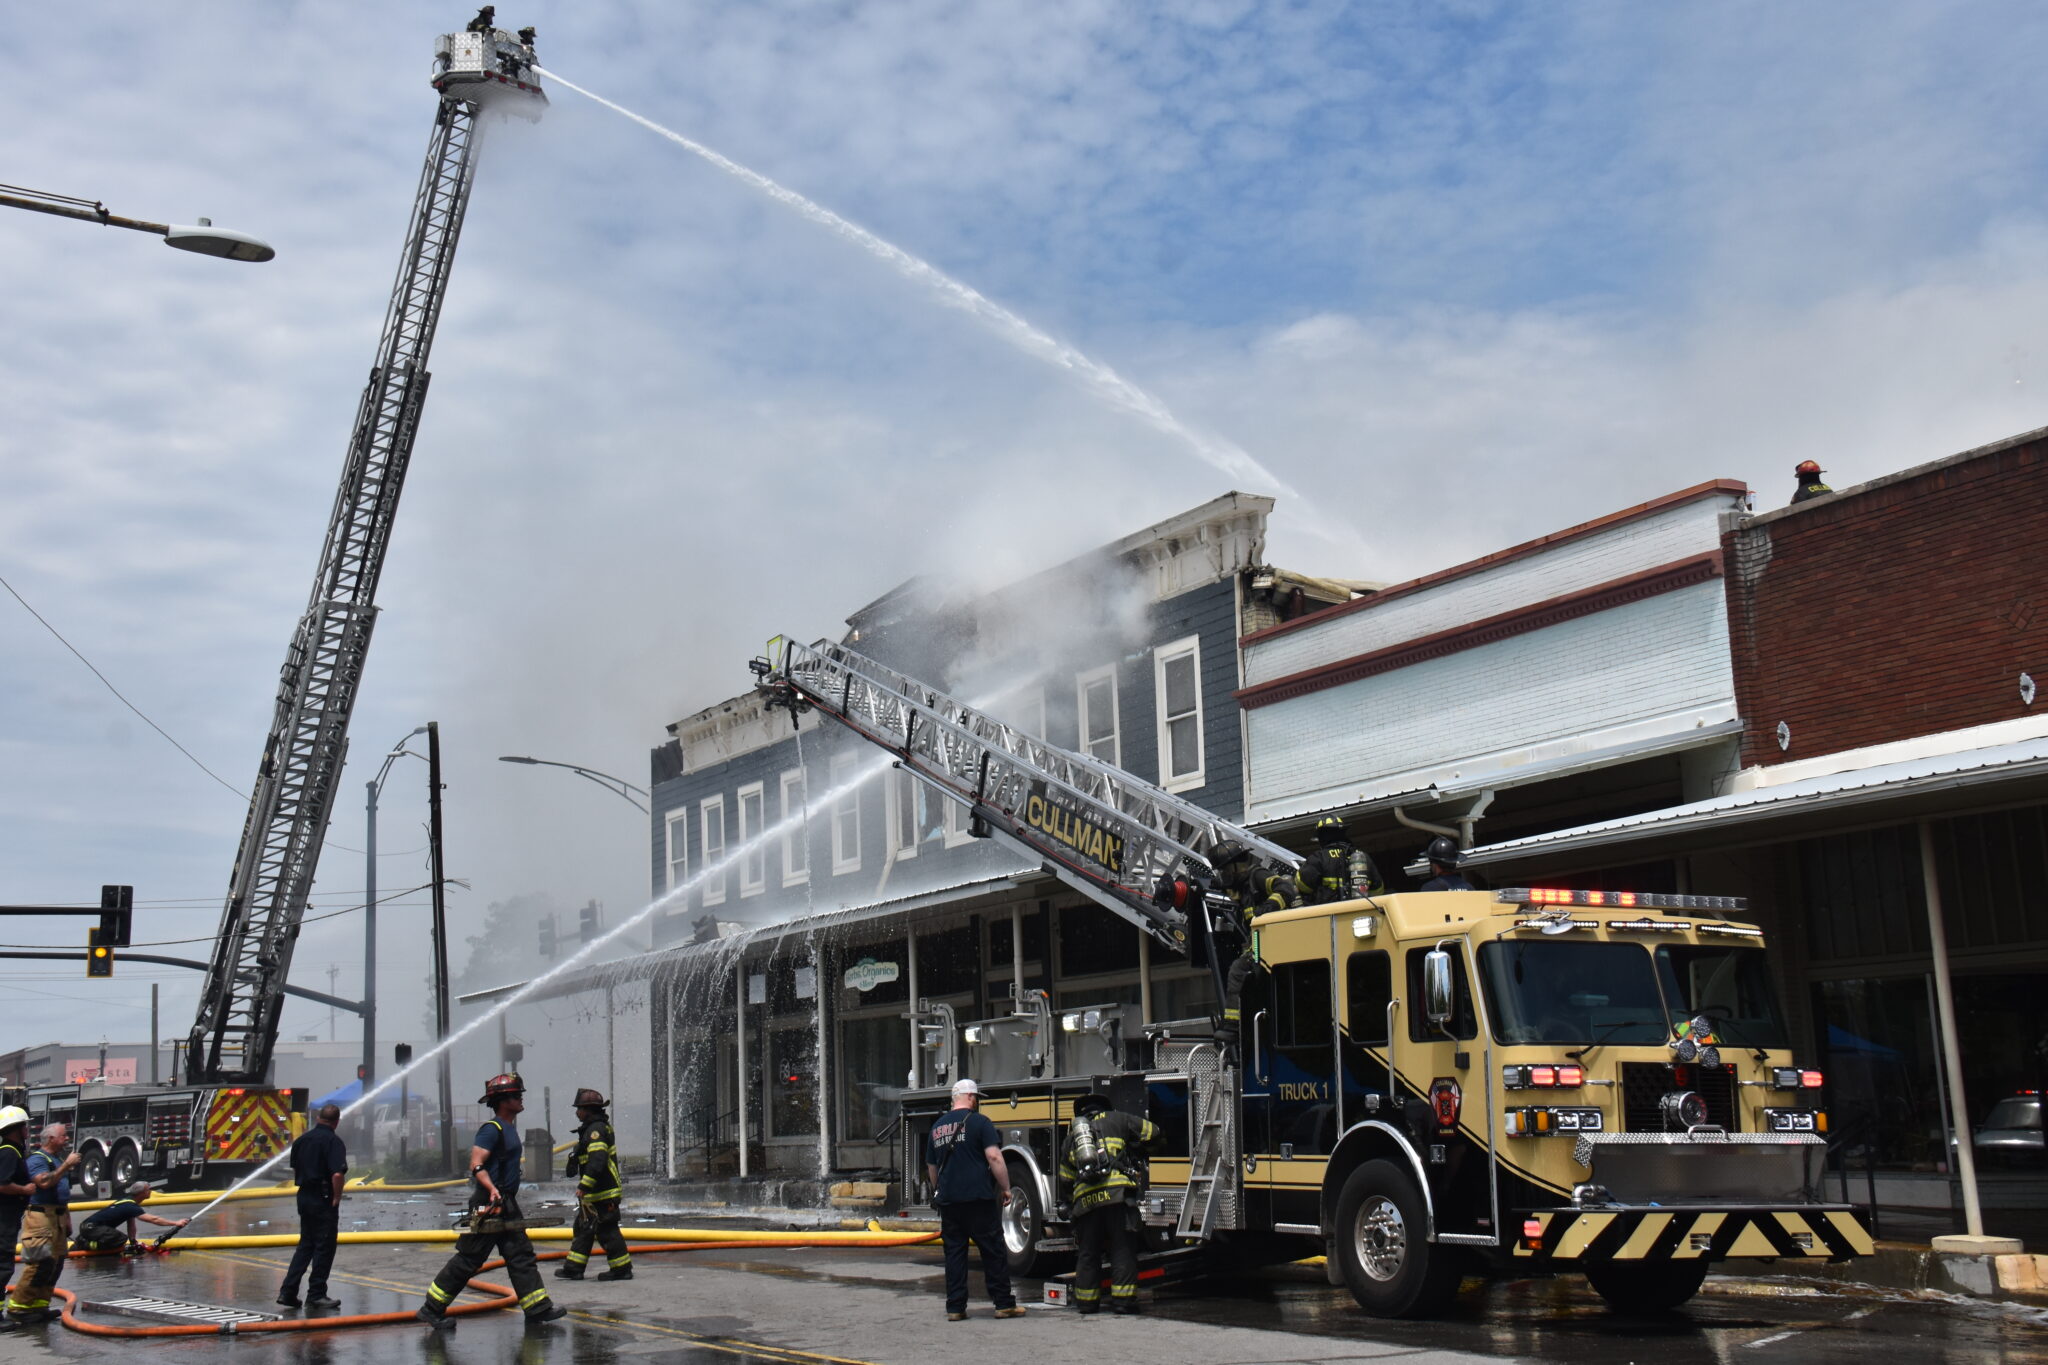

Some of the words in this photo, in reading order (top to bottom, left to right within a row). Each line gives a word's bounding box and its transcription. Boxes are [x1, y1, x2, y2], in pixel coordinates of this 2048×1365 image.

[1027, 794, 1121, 871] CULLMAN
[862, 966, 896, 980] Organics
[1278, 1081, 1319, 1101] TRUCK
[1322, 1081, 1328, 1099] 1
[1081, 1190, 1111, 1208] BROCK
